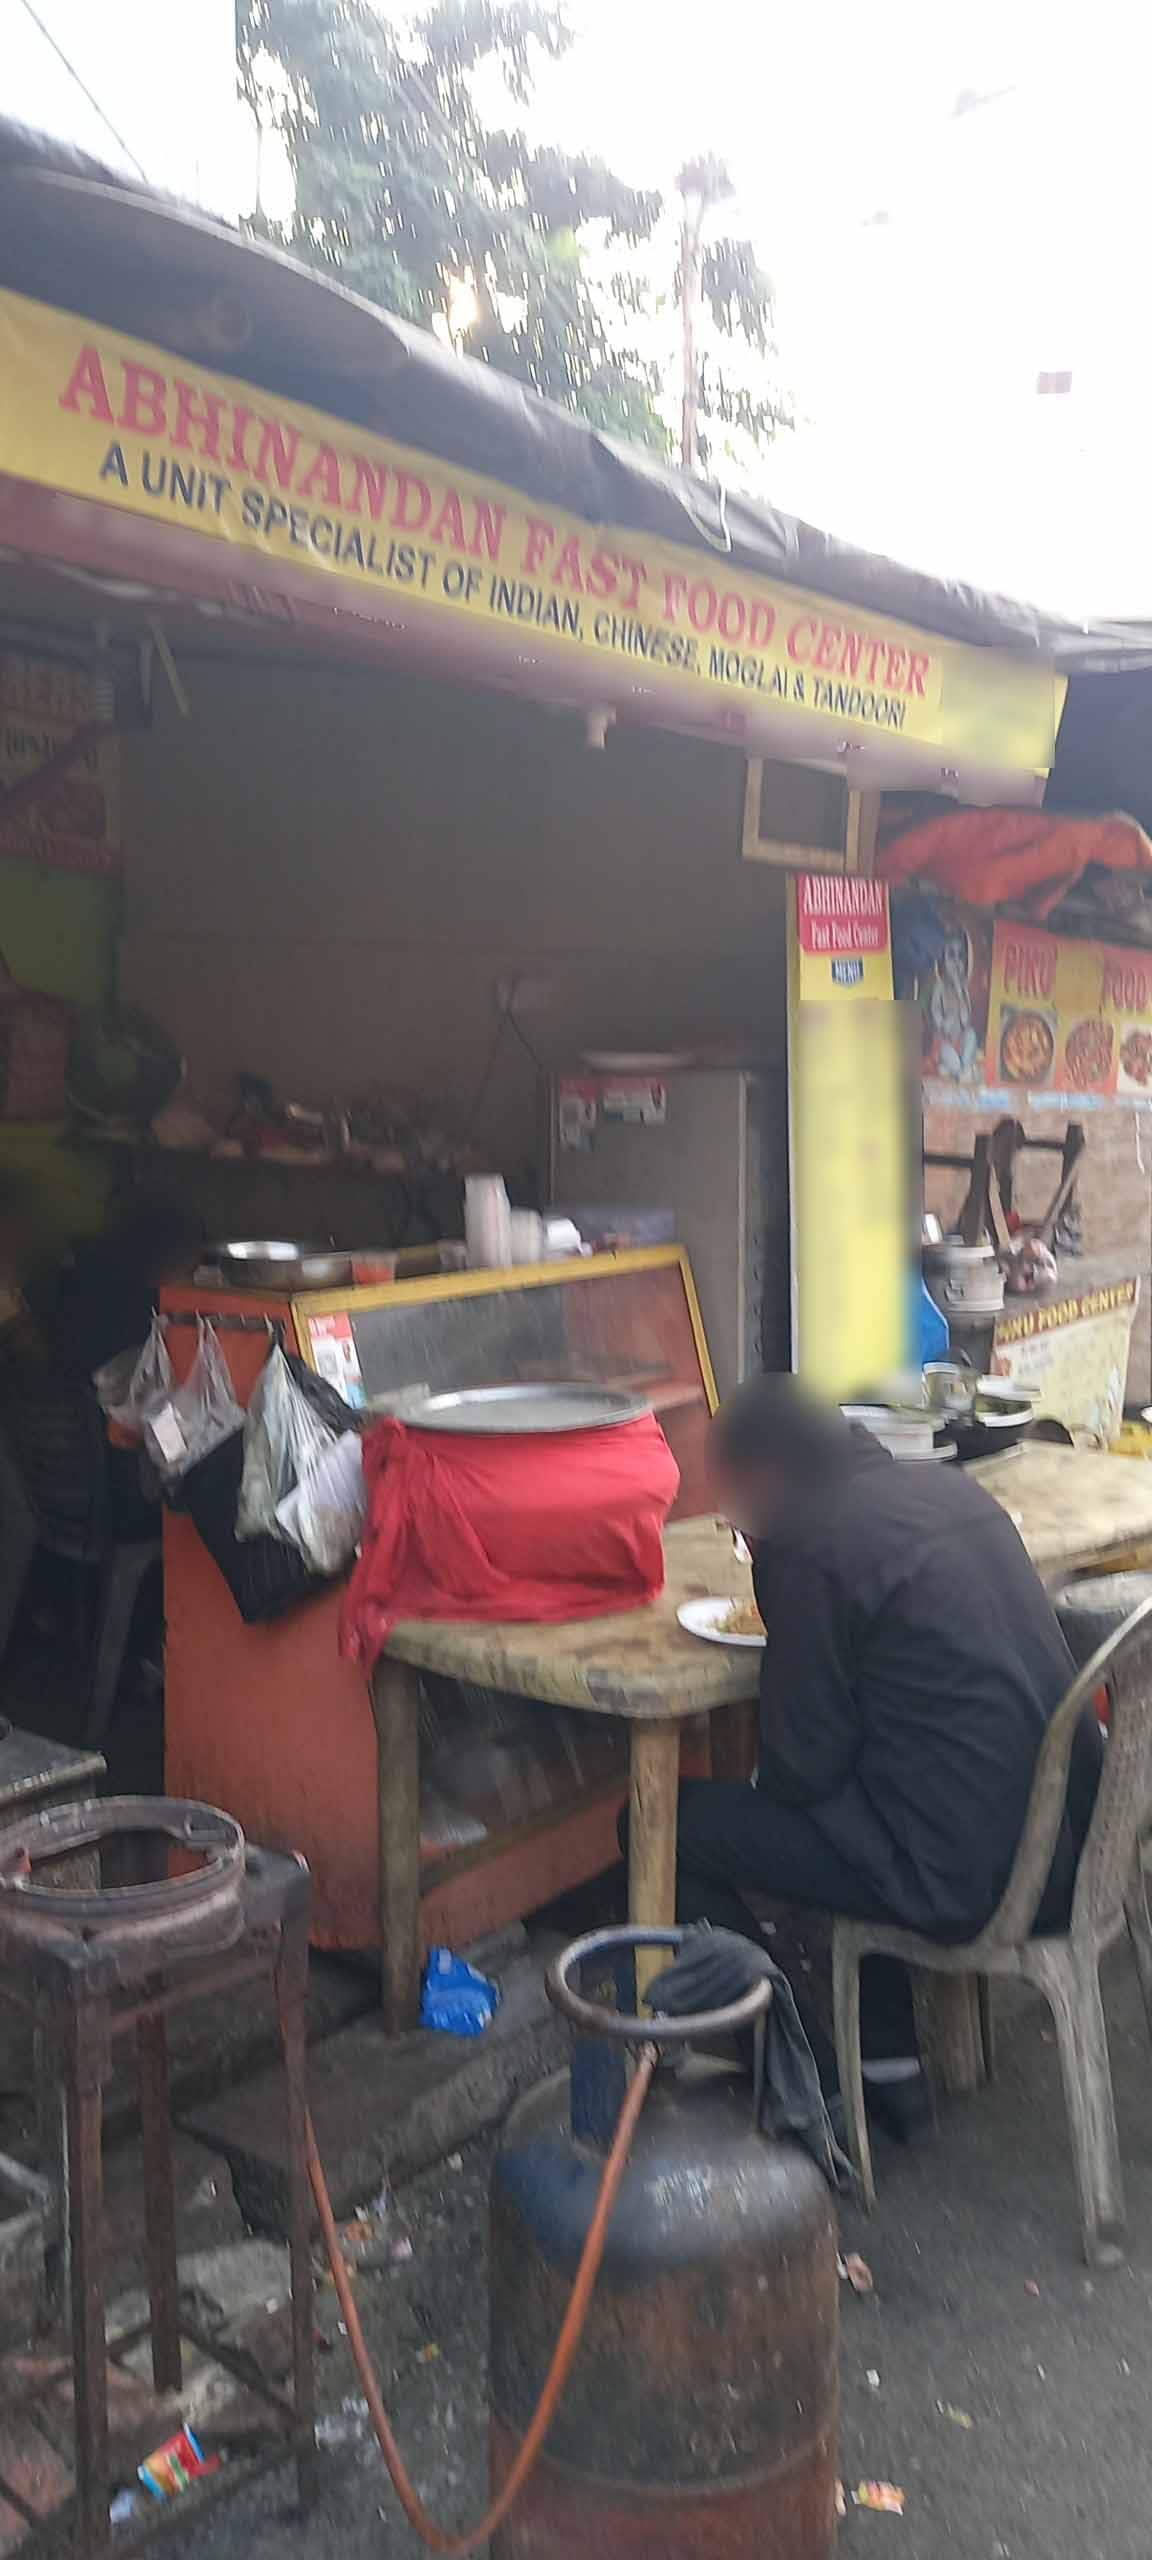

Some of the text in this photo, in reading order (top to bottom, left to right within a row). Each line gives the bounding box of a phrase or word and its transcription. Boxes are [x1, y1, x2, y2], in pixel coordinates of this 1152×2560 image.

[58, 344, 929, 697] ABHINANDAN FAST FOOD CENTER
[99, 440, 906, 730] A UNIT SPECIALIST OF INDIAN, CHINESE, MOGLAI & TANDOORI
[803, 875, 883, 917] ABHINANDAN
[810, 920, 831, 949] Fast
[831, 920, 853, 949] Food
